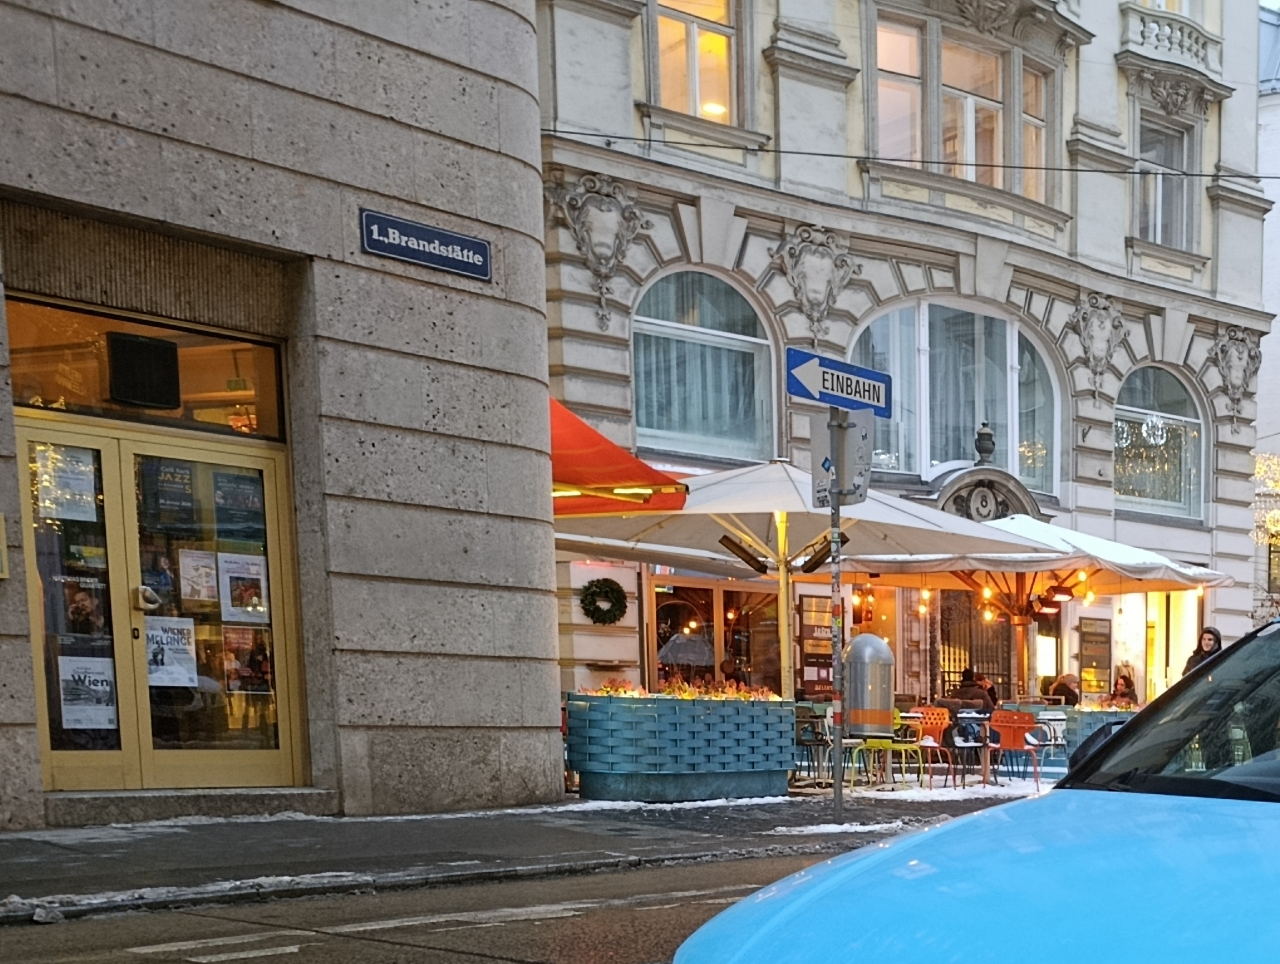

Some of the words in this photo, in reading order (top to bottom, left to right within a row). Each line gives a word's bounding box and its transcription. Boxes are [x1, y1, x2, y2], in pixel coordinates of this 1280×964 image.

[388, 227, 484, 265] Brandstätte
[822, 369, 881, 403] EINBAHN
[980, 494, 988, 508] 8
[161, 626, 192, 636] WIENER
[71, 674, 110, 687] Wien
